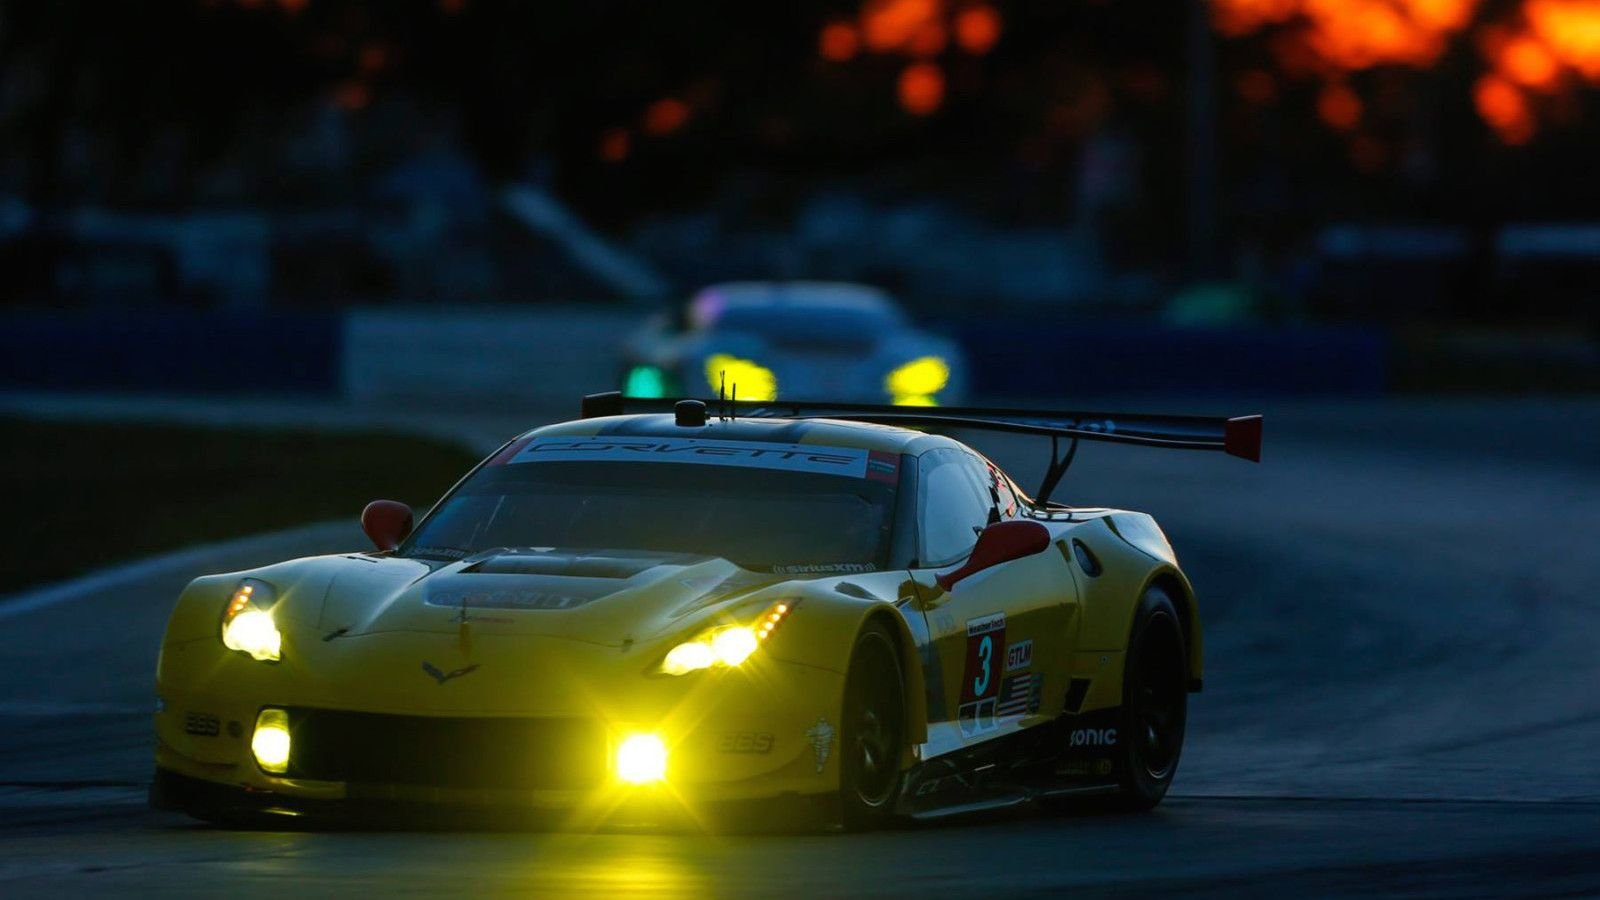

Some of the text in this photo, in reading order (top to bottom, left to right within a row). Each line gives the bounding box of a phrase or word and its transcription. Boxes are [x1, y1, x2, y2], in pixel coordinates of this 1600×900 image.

[528, 442, 858, 464] CORVETTE
[973, 634, 993, 697] 3
[1008, 643, 1032, 667] GTLM
